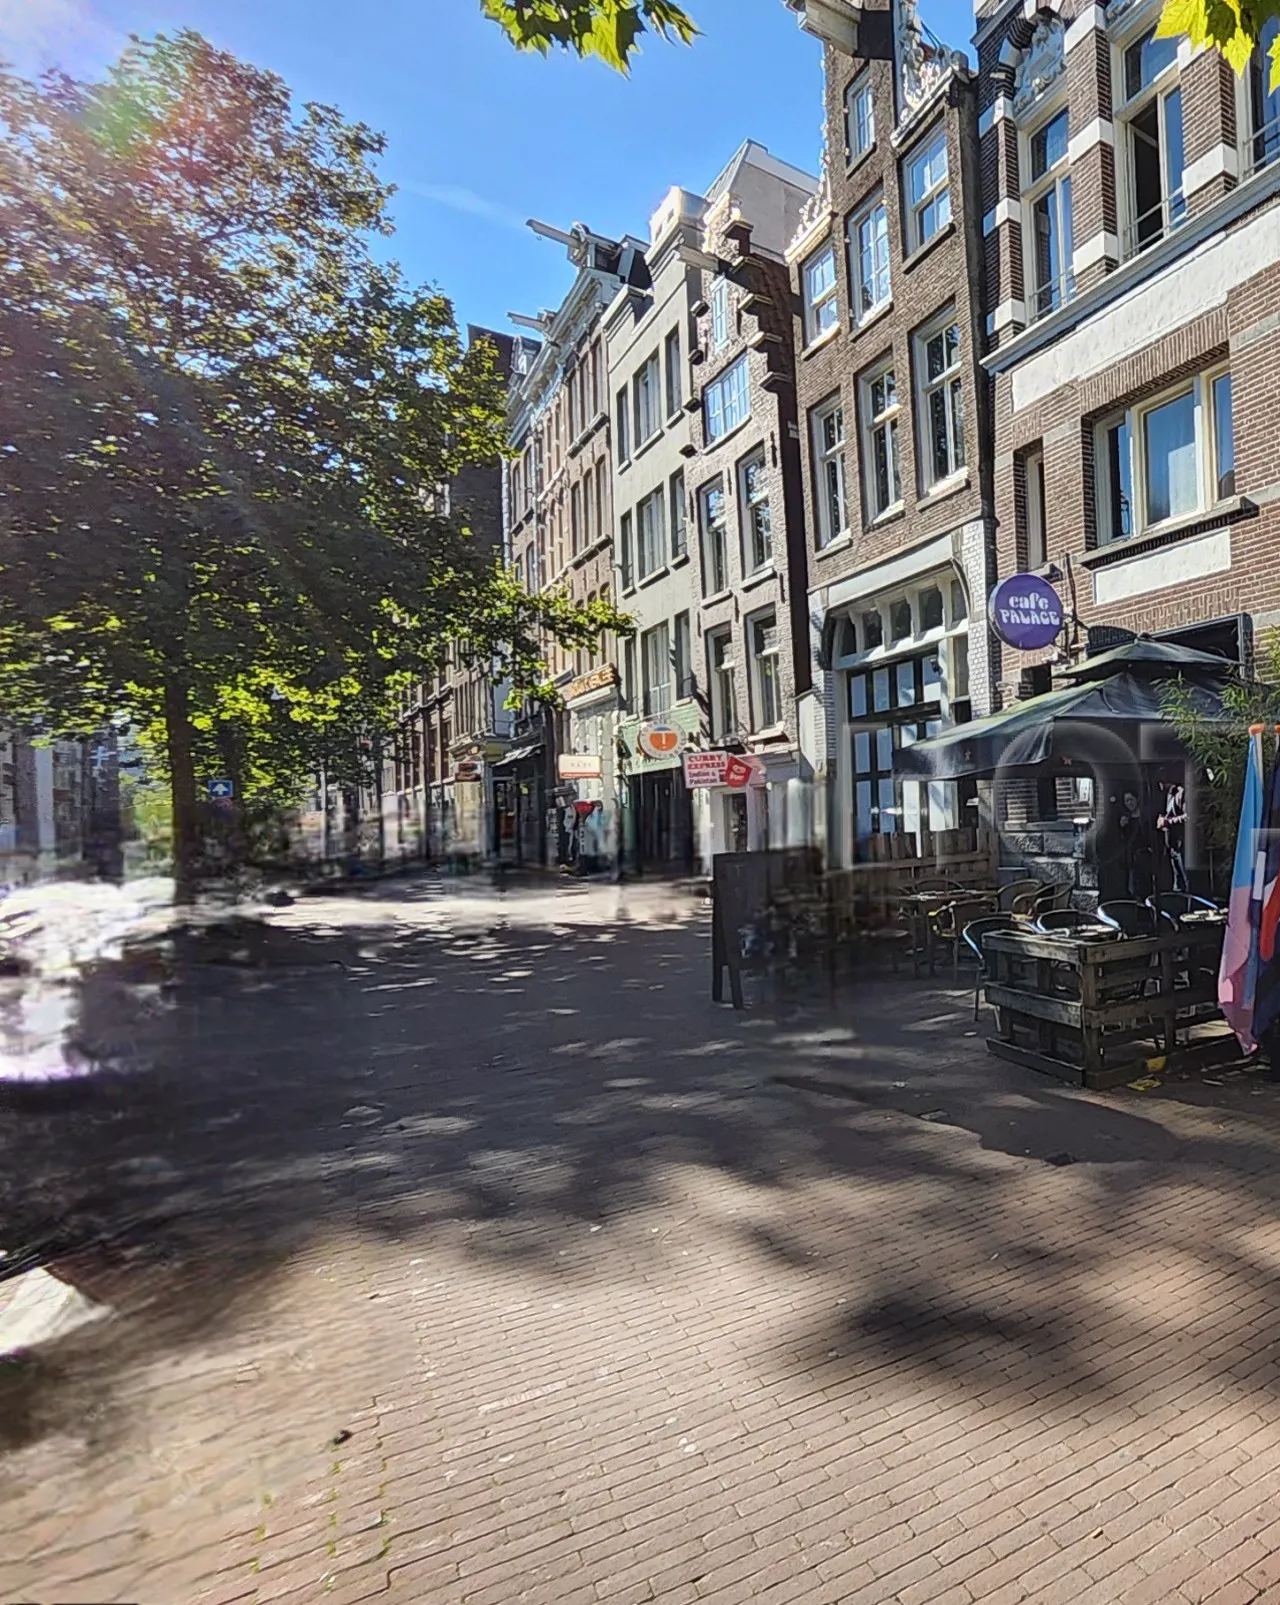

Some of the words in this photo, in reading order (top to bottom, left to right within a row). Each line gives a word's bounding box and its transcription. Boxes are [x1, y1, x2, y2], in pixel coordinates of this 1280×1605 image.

[1009, 592, 1049, 610] cafe
[999, 609, 1060, 626] PALACE
[688, 754, 723, 762] CURRY
